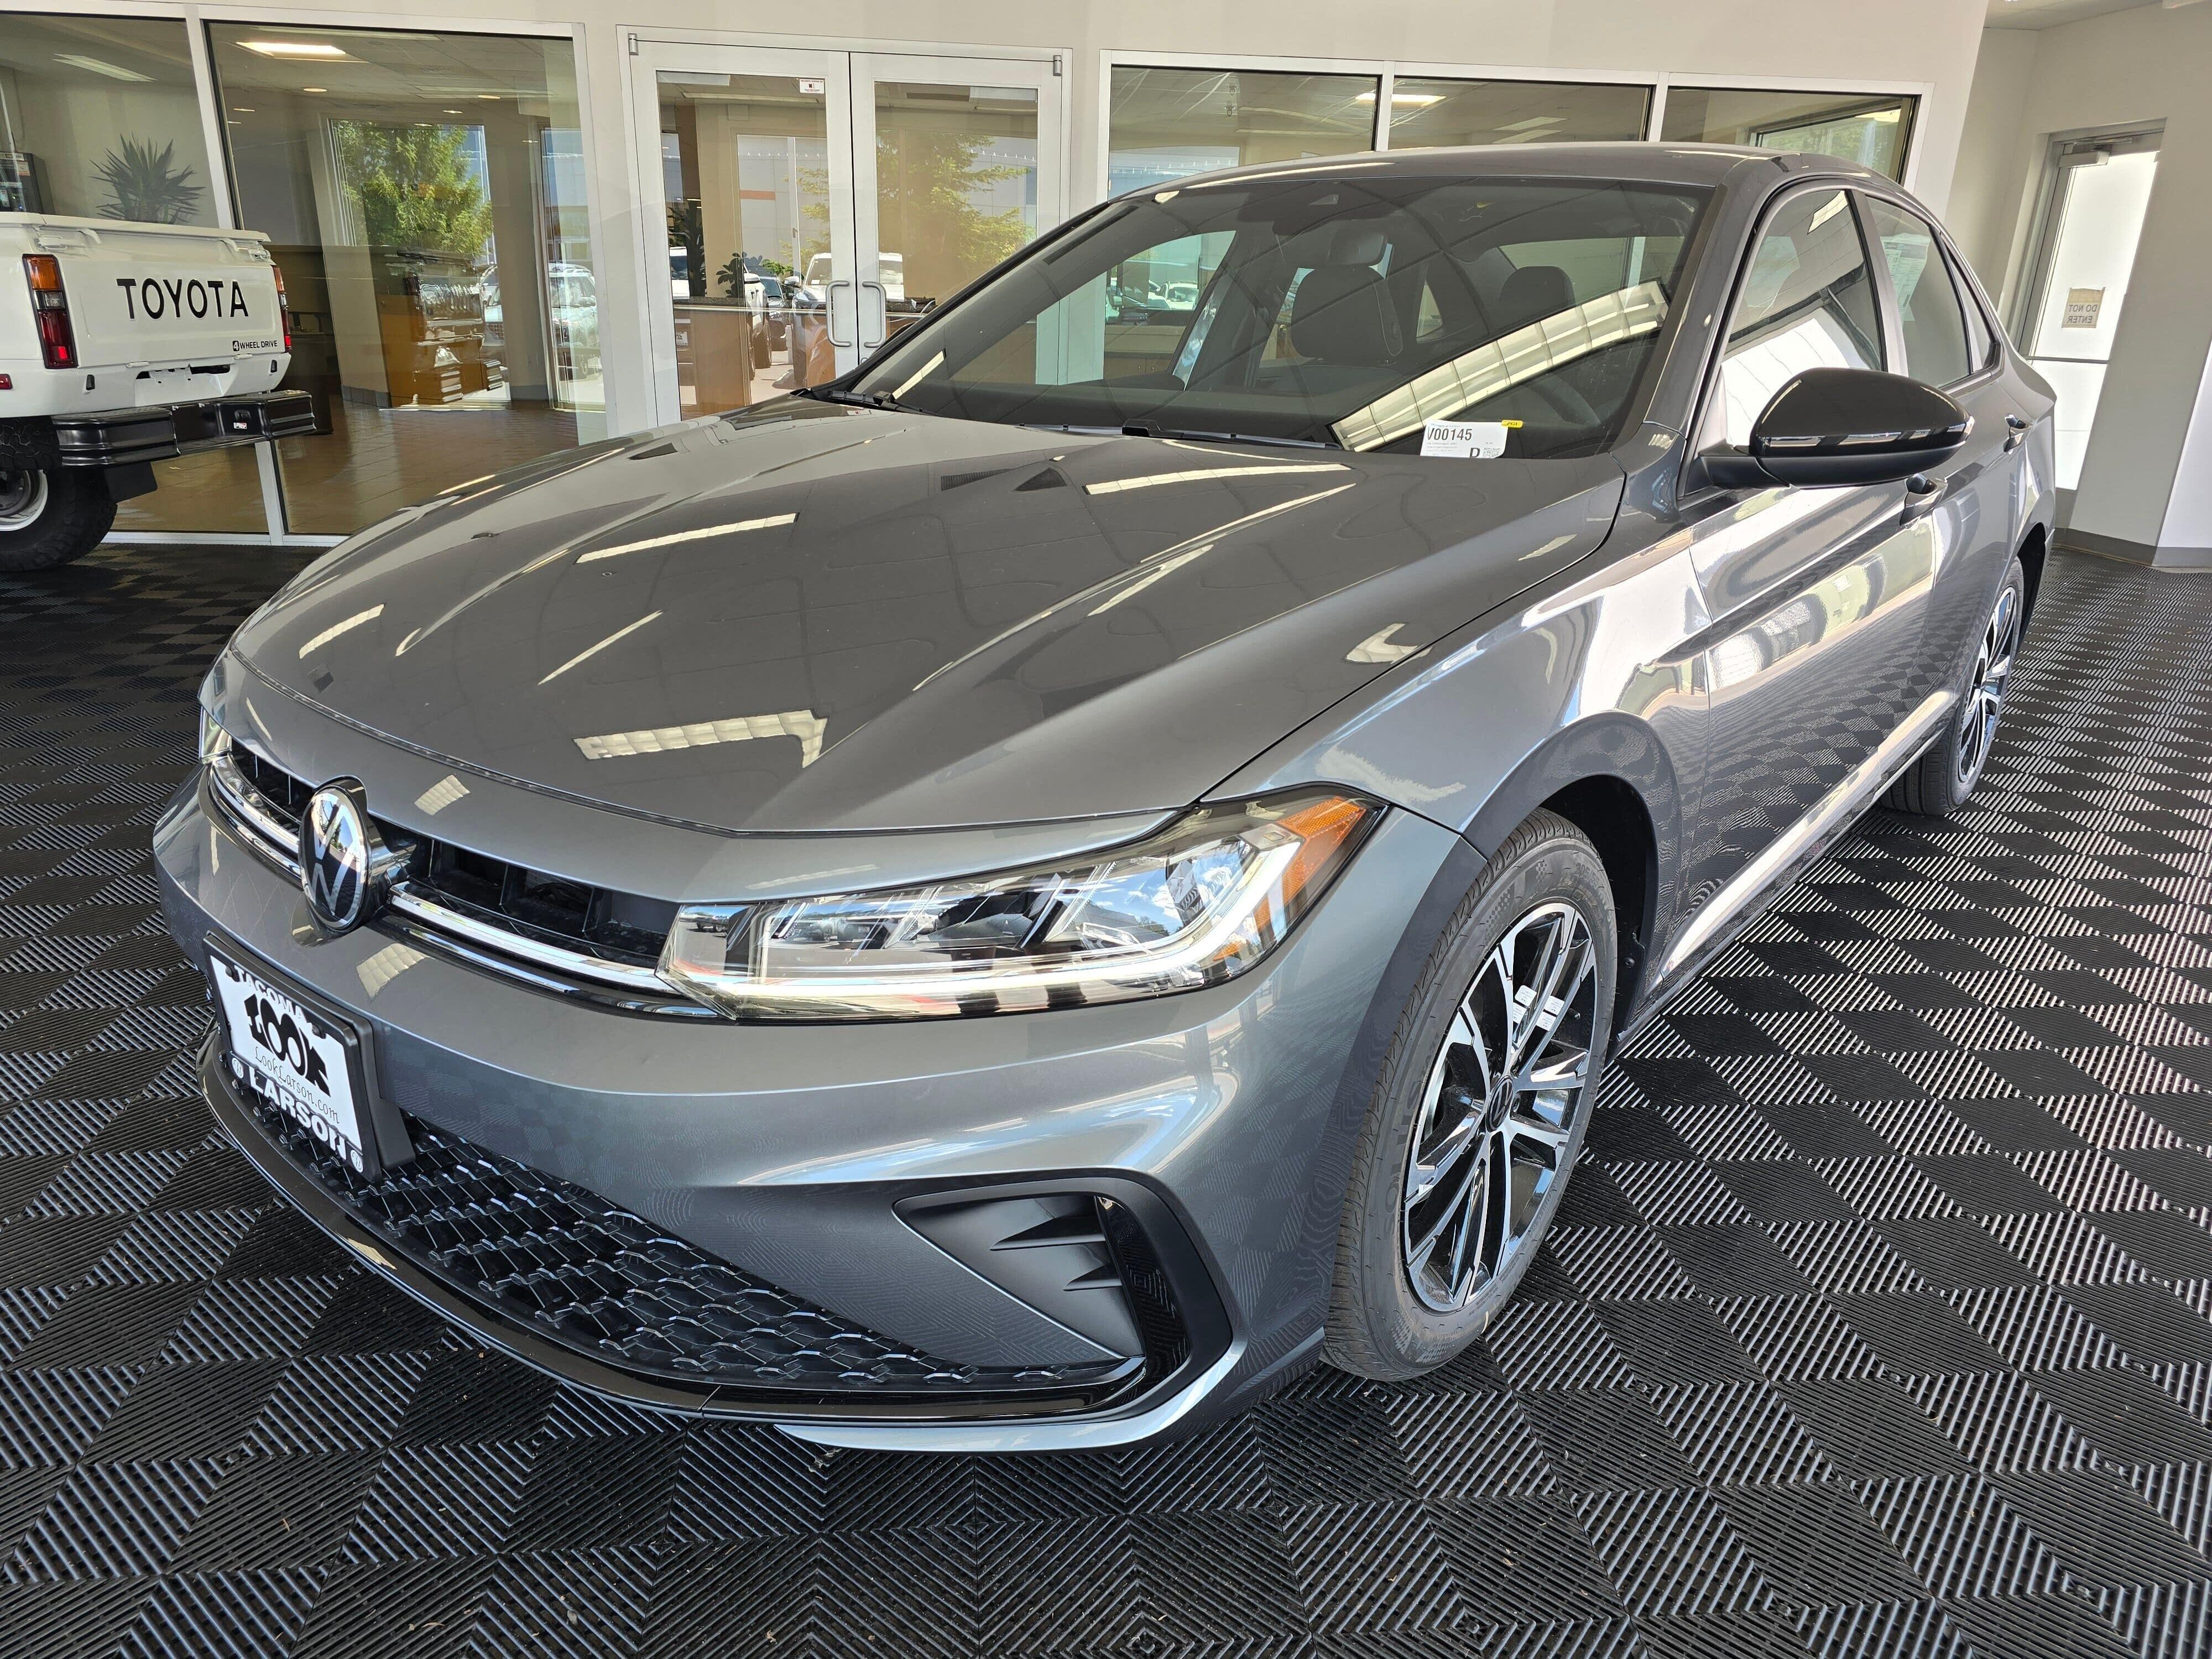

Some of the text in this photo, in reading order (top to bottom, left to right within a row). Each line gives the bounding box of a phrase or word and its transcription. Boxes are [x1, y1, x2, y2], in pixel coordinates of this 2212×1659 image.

[116, 278, 248, 319] TOYOTA
[1427, 426, 1473, 441] V00145
[234, 965, 306, 1020] TACOMA
[244, 994, 331, 1097] LOOK
[248, 1066, 347, 1160] LARSON
[254, 1046, 340, 1124] LookLarson.com
